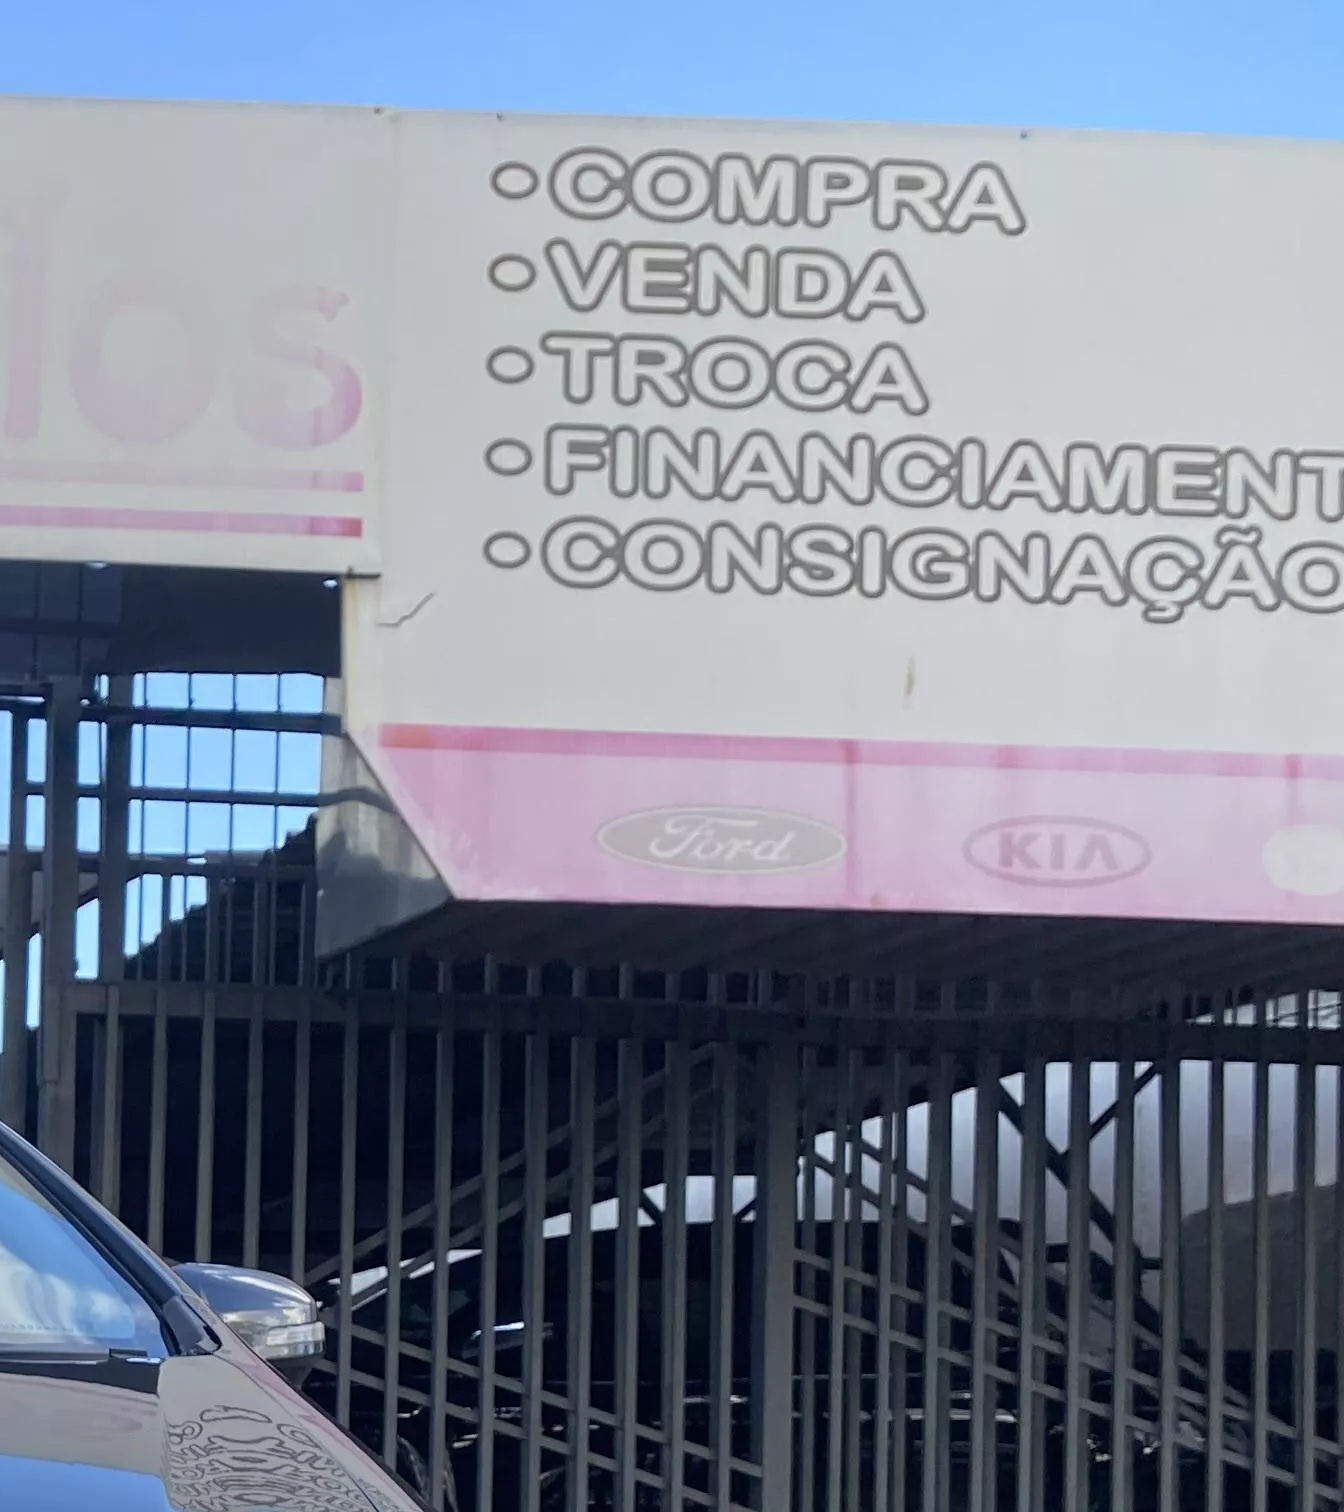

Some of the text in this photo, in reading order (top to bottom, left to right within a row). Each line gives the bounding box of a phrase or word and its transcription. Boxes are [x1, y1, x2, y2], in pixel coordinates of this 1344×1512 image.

[548, 147, 1026, 234] COMPRA
[544, 238, 925, 322] VENDA
[540, 331, 929, 414] TROCA
[541, 517, 1344, 624] CONSIGNAÇÃO
[648, 813, 795, 862] Ford
[997, 831, 1120, 872] KIA
